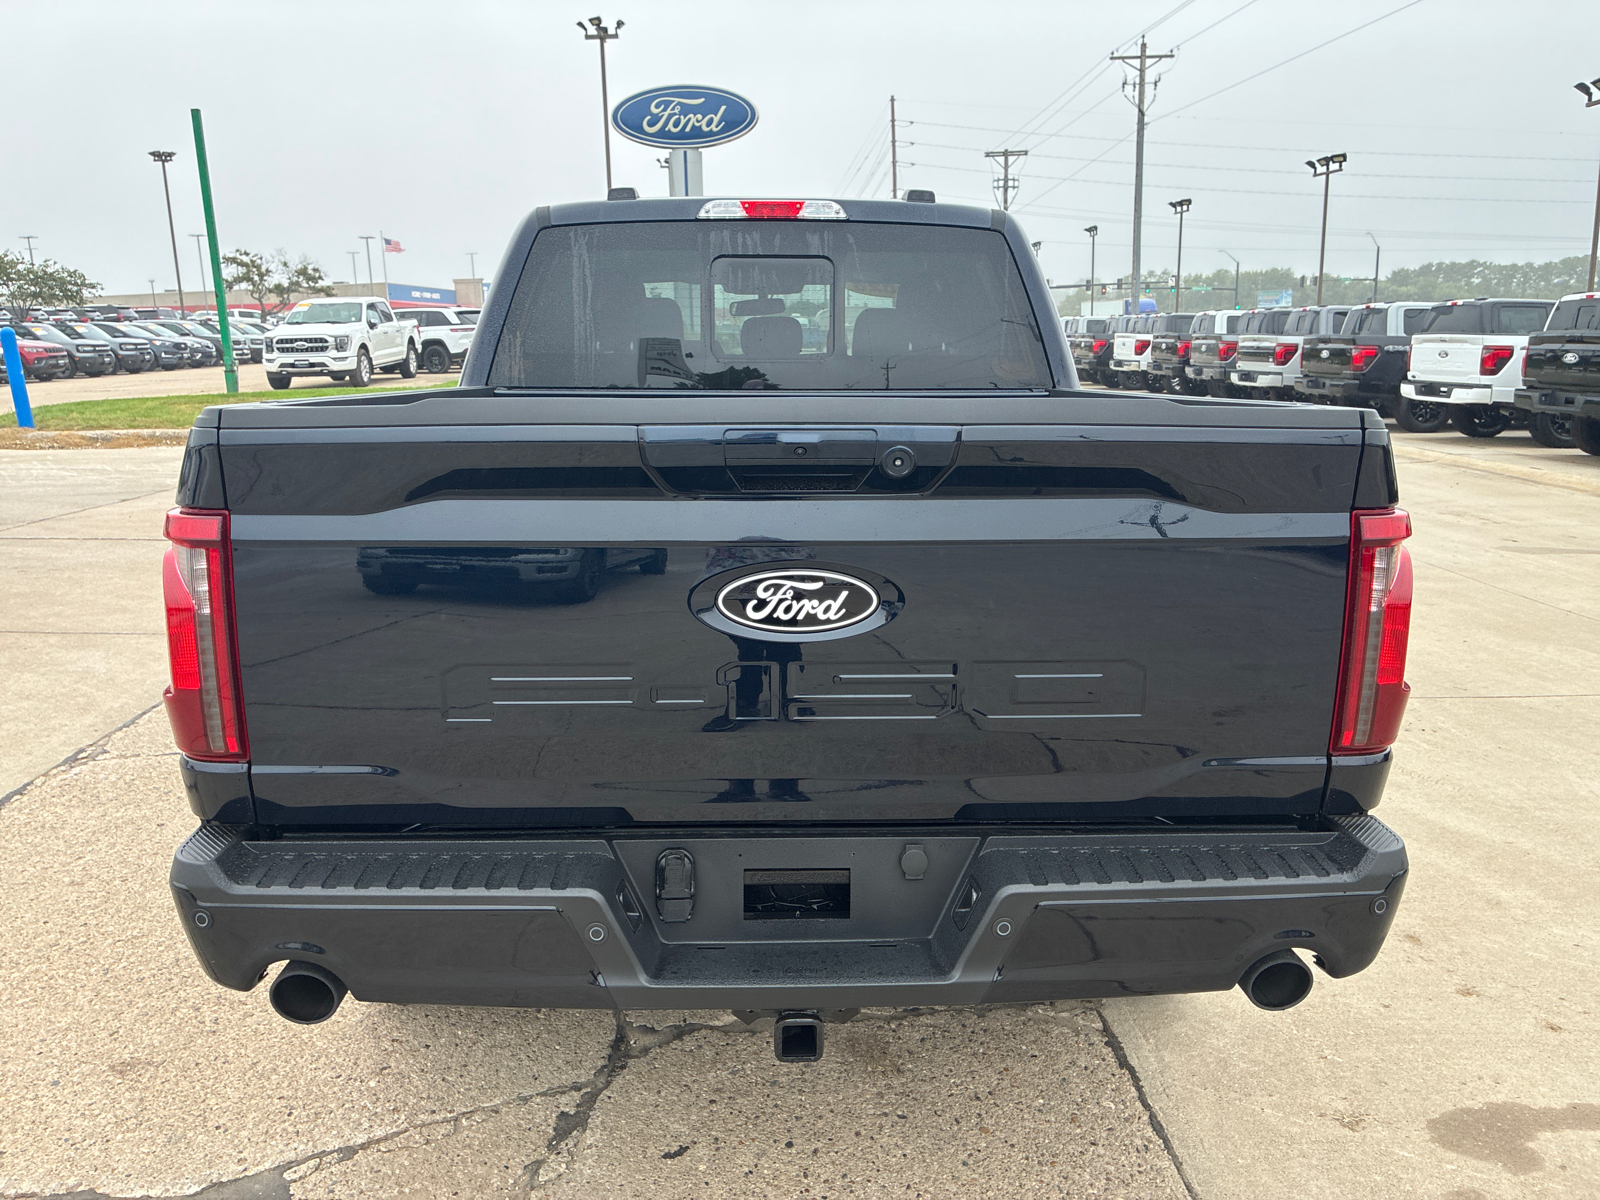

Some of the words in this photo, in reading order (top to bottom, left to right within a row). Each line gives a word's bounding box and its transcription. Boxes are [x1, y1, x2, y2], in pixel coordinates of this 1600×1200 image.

[642, 97, 727, 133] Ford
[746, 580, 849, 620] Ford
[441, 661, 1147, 722] F-150
